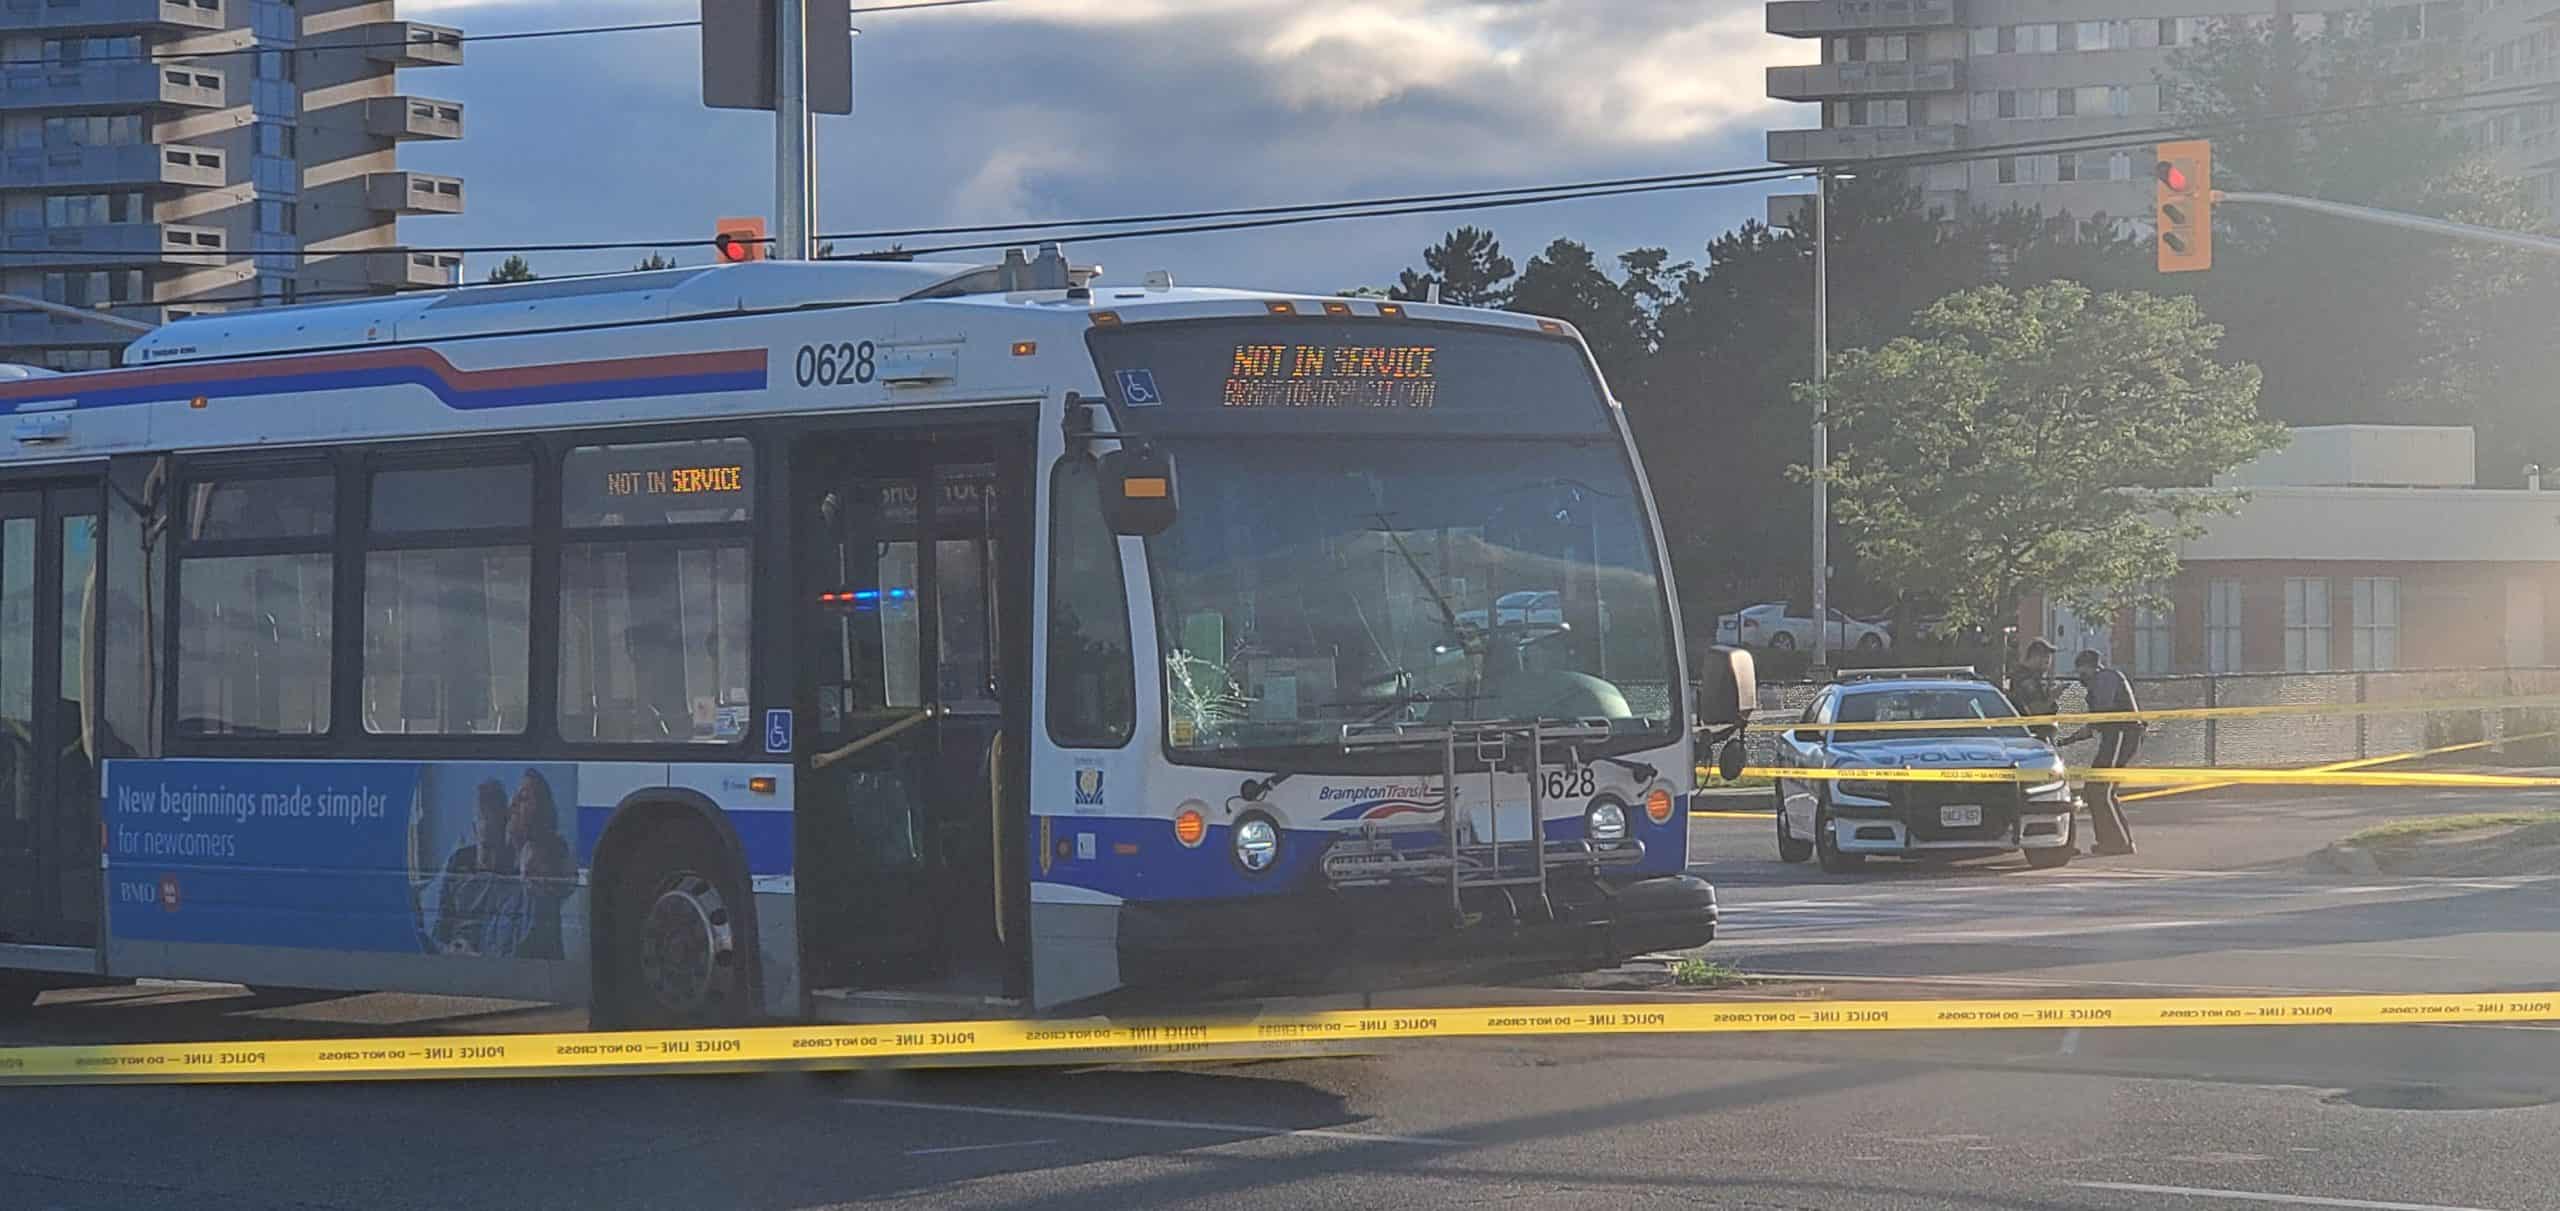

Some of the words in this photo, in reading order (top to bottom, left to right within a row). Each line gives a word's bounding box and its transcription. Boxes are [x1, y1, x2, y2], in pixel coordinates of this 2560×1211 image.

[796, 341, 875, 387] 0628
[1233, 345, 1287, 376] NOT
[1292, 345, 1325, 376] IN
[1332, 346, 1436, 377] SERVICE
[608, 472, 640, 495] NOT
[647, 471, 667, 493] IN
[672, 466, 742, 493] SERVICE
[1900, 751, 2008, 764] POLICE
[118, 784, 156, 813] New
[160, 782, 256, 823] beginnings
[261, 784, 312, 817] made
[317, 786, 387, 825] simpler
[1319, 785, 1431, 801] BramptonTransit
[118, 824, 138, 854] for
[144, 831, 235, 857] newcomers
[120, 881, 156, 903] BMO
